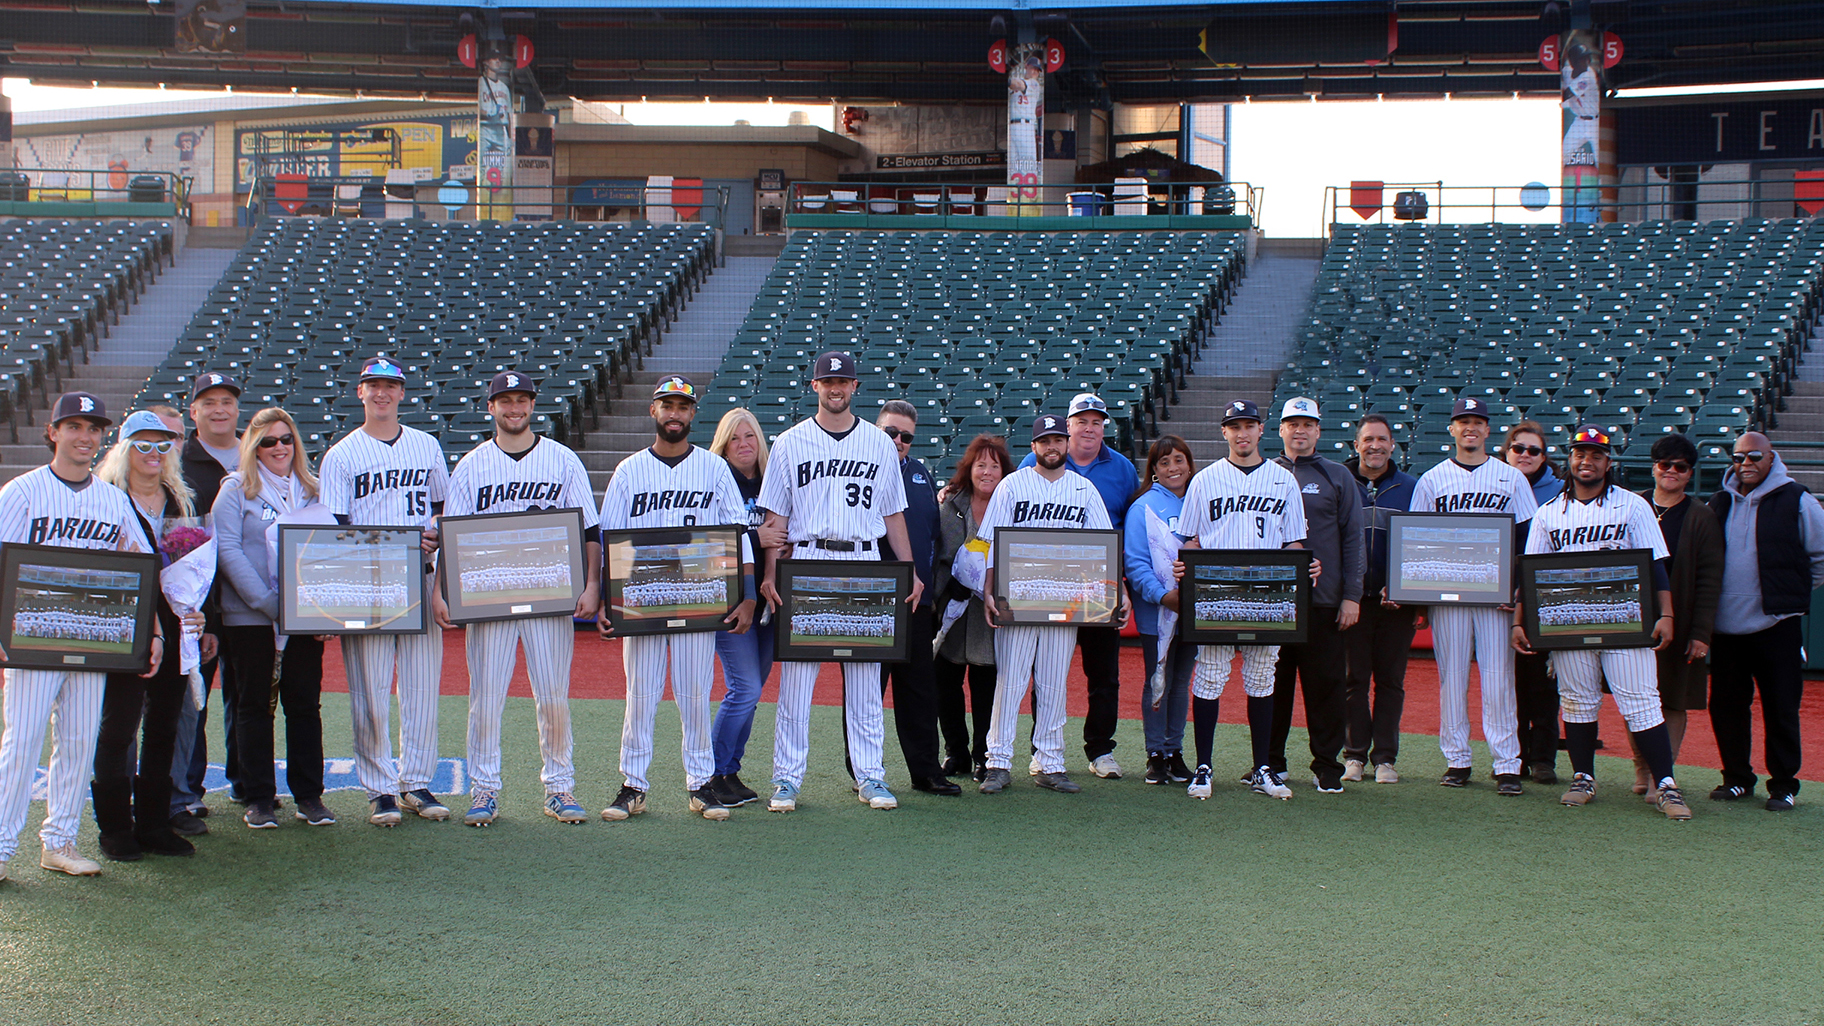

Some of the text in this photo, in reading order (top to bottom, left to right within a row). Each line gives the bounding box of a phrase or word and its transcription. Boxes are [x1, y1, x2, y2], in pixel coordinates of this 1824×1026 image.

[465, 44, 470, 59] 1
[523, 45, 528, 61] 1
[993, 49, 1002, 64] 3
[1050, 48, 1060, 64] 3
[1543, 45, 1554, 61] 5
[1606, 42, 1617, 58] 5
[482, 155, 506, 168] NIMMO
[941, 154, 981, 166] Station
[487, 167, 502, 193] 9
[1011, 172, 1038, 199] 39
[797, 459, 879, 488] BARUCH
[405, 491, 427, 516] 15
[477, 482, 563, 512] BARUCH
[630, 490, 714, 517] BARUCH
[845, 483, 873, 510] 39
[1209, 495, 1286, 522] BARUCH
[1435, 492, 1511, 512] BARUCH
[1014, 500, 1086, 524] BARUCH
[28, 516, 121, 545] BARUCH
[1255, 517, 1265, 538] 9
[1549, 523, 1628, 551] BARUCH
